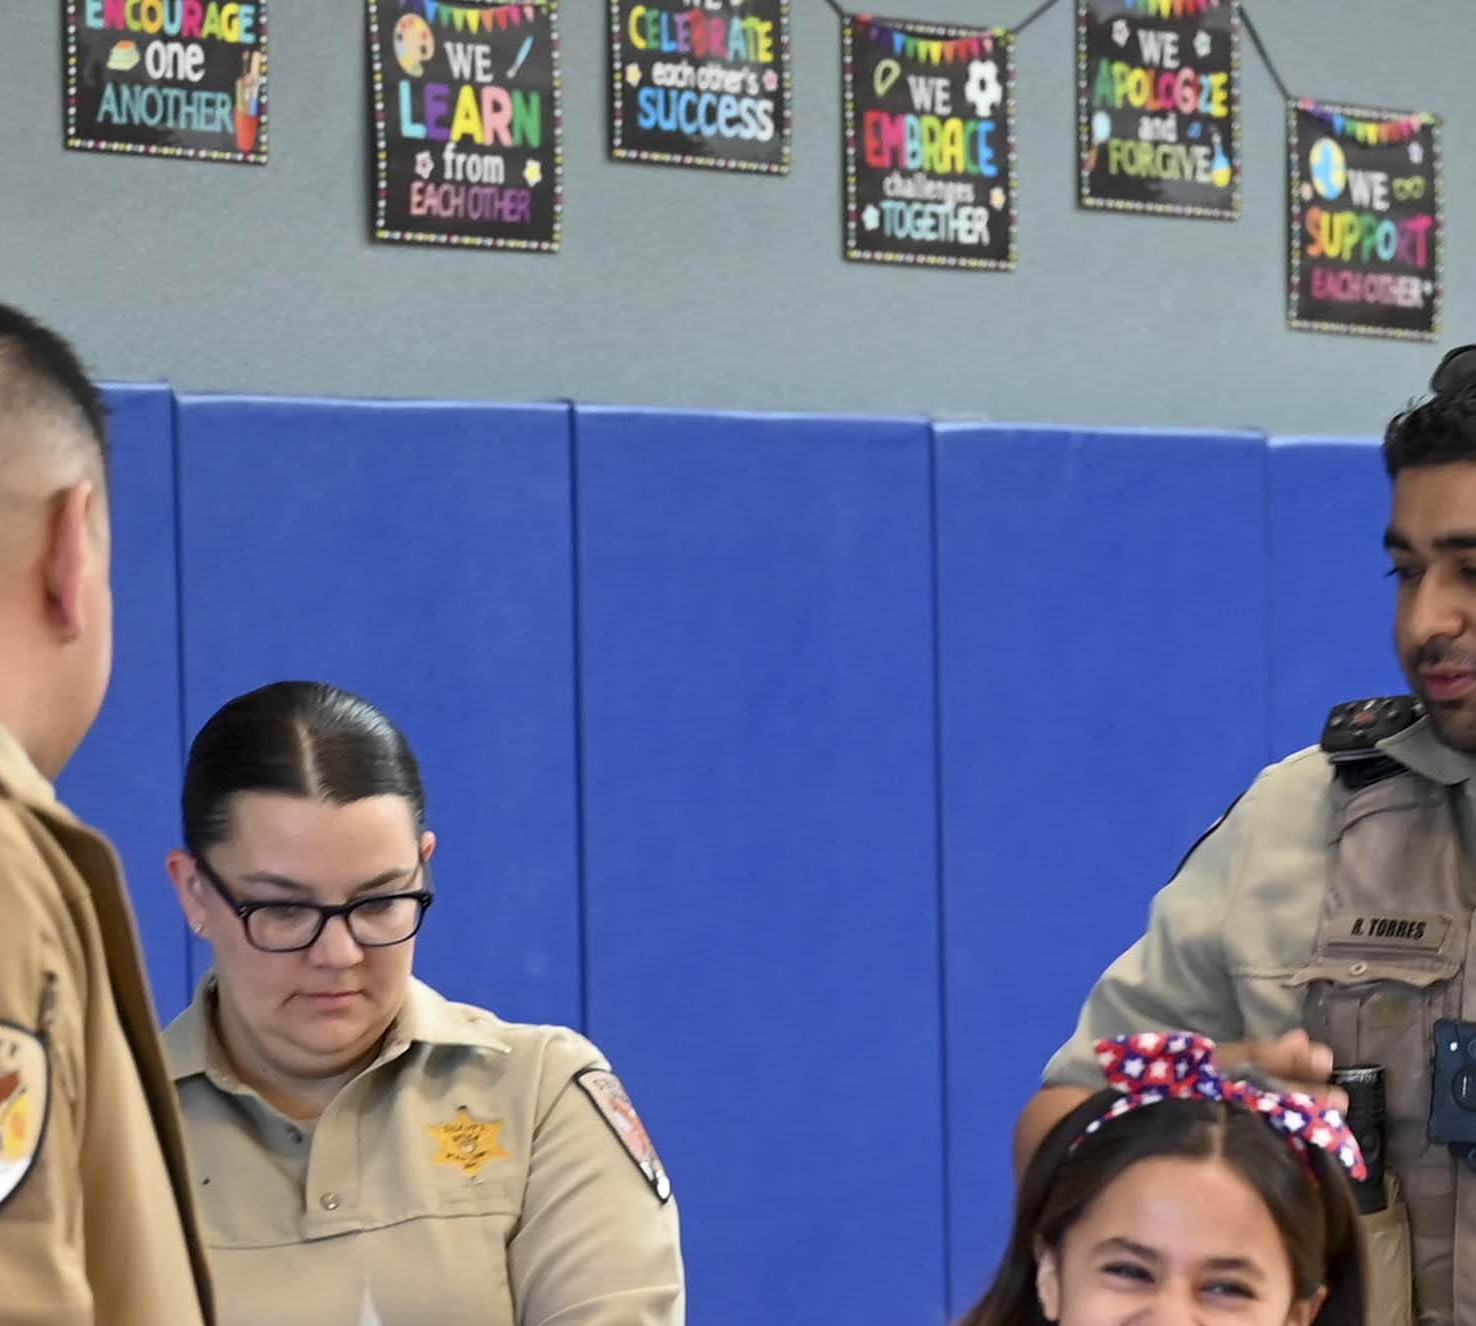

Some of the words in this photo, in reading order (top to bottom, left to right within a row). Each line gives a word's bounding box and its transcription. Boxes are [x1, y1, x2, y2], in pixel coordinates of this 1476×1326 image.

[85, 0, 256, 44] ENCOURAGE
[628, 5, 774, 63] CELEBRATE
[145, 40, 205, 82] one
[443, 41, 493, 82] WE
[1137, 29, 1180, 68] WE
[651, 58, 695, 87] each
[697, 62, 759, 95] other's
[908, 75, 952, 115] WE
[1094, 58, 1229, 117] APOLOGIZE
[96, 82, 233, 133] ANOTHER
[399, 79, 541, 147] LEARN
[1138, 112, 1178, 142] and
[443, 141, 504, 184] from
[864, 109, 998, 176] EMBRACE
[1108, 138, 1213, 183] FORGIVE
[409, 180, 464, 217] EACH
[467, 187, 531, 222] OTHER
[882, 169, 975, 204] challenges
[1347, 169, 1390, 211] WE
[880, 200, 990, 246] TOGETHER
[1305, 207, 1433, 268] SUPPORT
[1363, 273, 1424, 308] OTHER
[1368, 917, 1428, 940] TORRES
